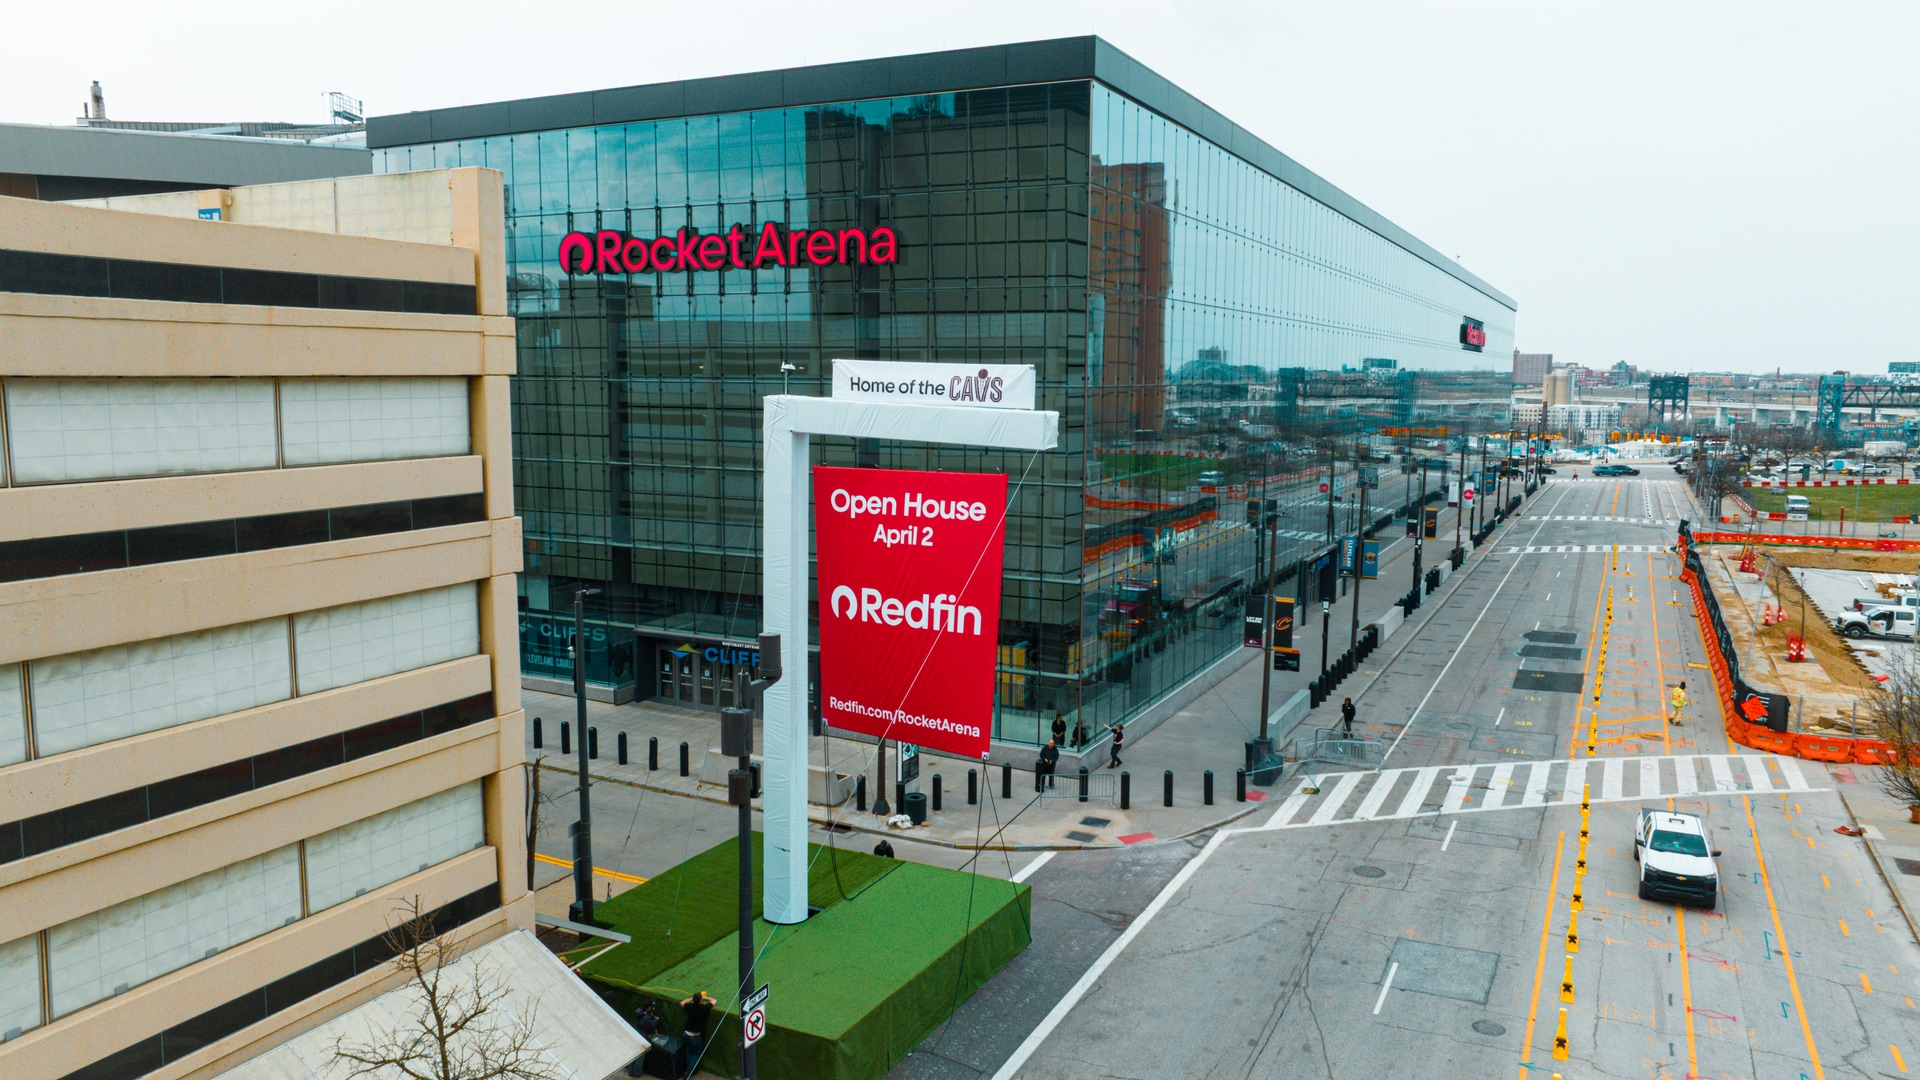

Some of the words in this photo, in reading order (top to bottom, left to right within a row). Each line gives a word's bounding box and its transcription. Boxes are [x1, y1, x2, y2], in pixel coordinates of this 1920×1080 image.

[597, 225, 745, 273] Rocket
[753, 222, 896, 267] Arena
[850, 376, 896, 394] Home
[898, 379, 917, 395] of
[918, 380, 946, 396] the
[949, 368, 1004, 403] CAVS
[830, 488, 897, 520] Open
[903, 492, 987, 523] House
[873, 523, 918, 549] April
[920, 526, 934, 547] 2
[861, 586, 982, 636] Redfin
[704, 646, 761, 668] CLIFF
[829, 696, 981, 739] Redfin.com/RocketArena
